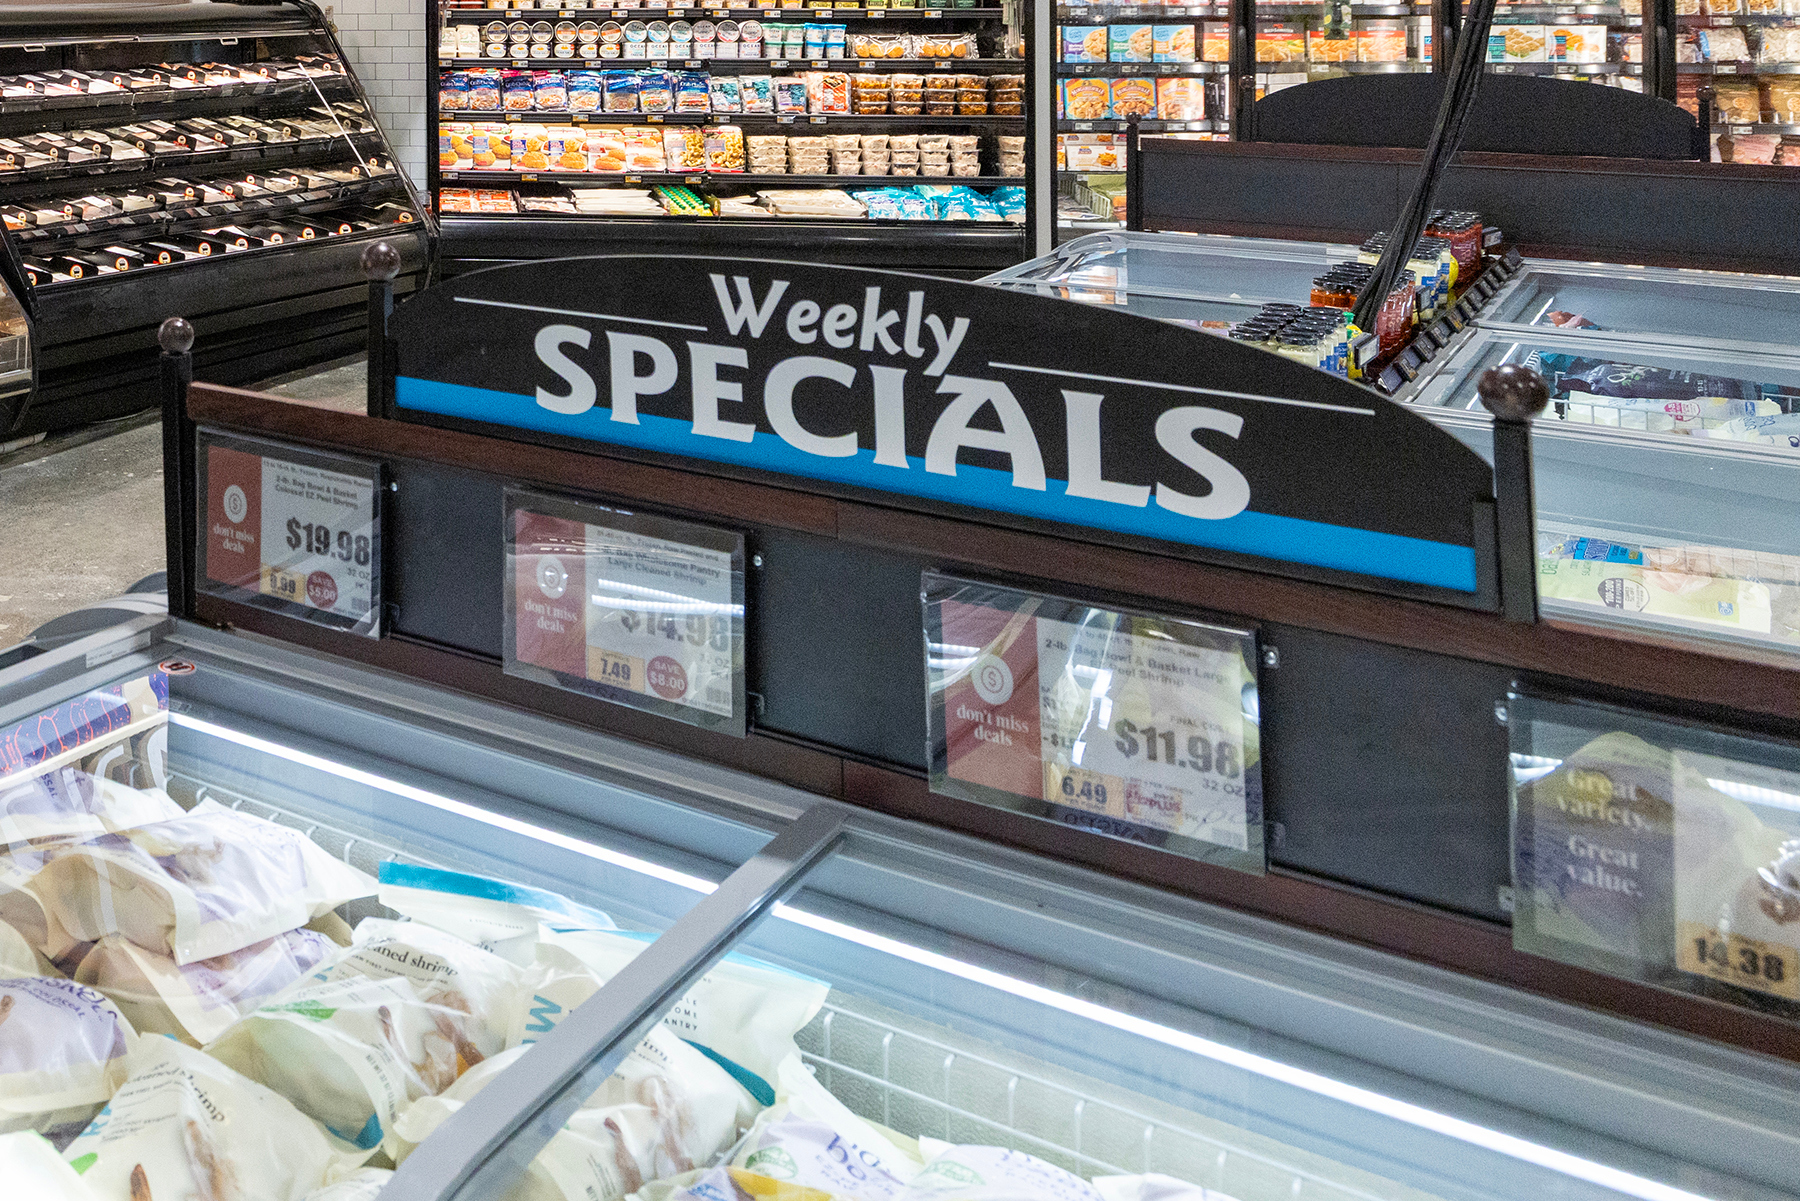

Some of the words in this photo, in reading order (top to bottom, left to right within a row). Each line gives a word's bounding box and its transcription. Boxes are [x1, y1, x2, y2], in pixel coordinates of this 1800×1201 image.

[709, 272, 970, 377] Weekly
[534, 323, 1250, 520] SPECIALS
[213, 523, 234, 537] don't
[236, 531, 254, 543] miss
[286, 517, 370, 566] $19.98
[222, 538, 245, 553] deals
[525, 600, 551, 618] don't
[554, 608, 577, 622] miss
[537, 616, 565, 633] deals
[654, 661, 680, 674] SAVE
[650, 671, 685, 690] $8.00
[956, 705, 992, 725] don't
[996, 716, 1029, 733] miss
[974, 726, 1013, 746] deals
[1114, 718, 1240, 779] $11.98
[1062, 776, 1108, 804] 6.49
[1568, 834, 1639, 870] Great
[410, 956, 459, 976] shrimp
